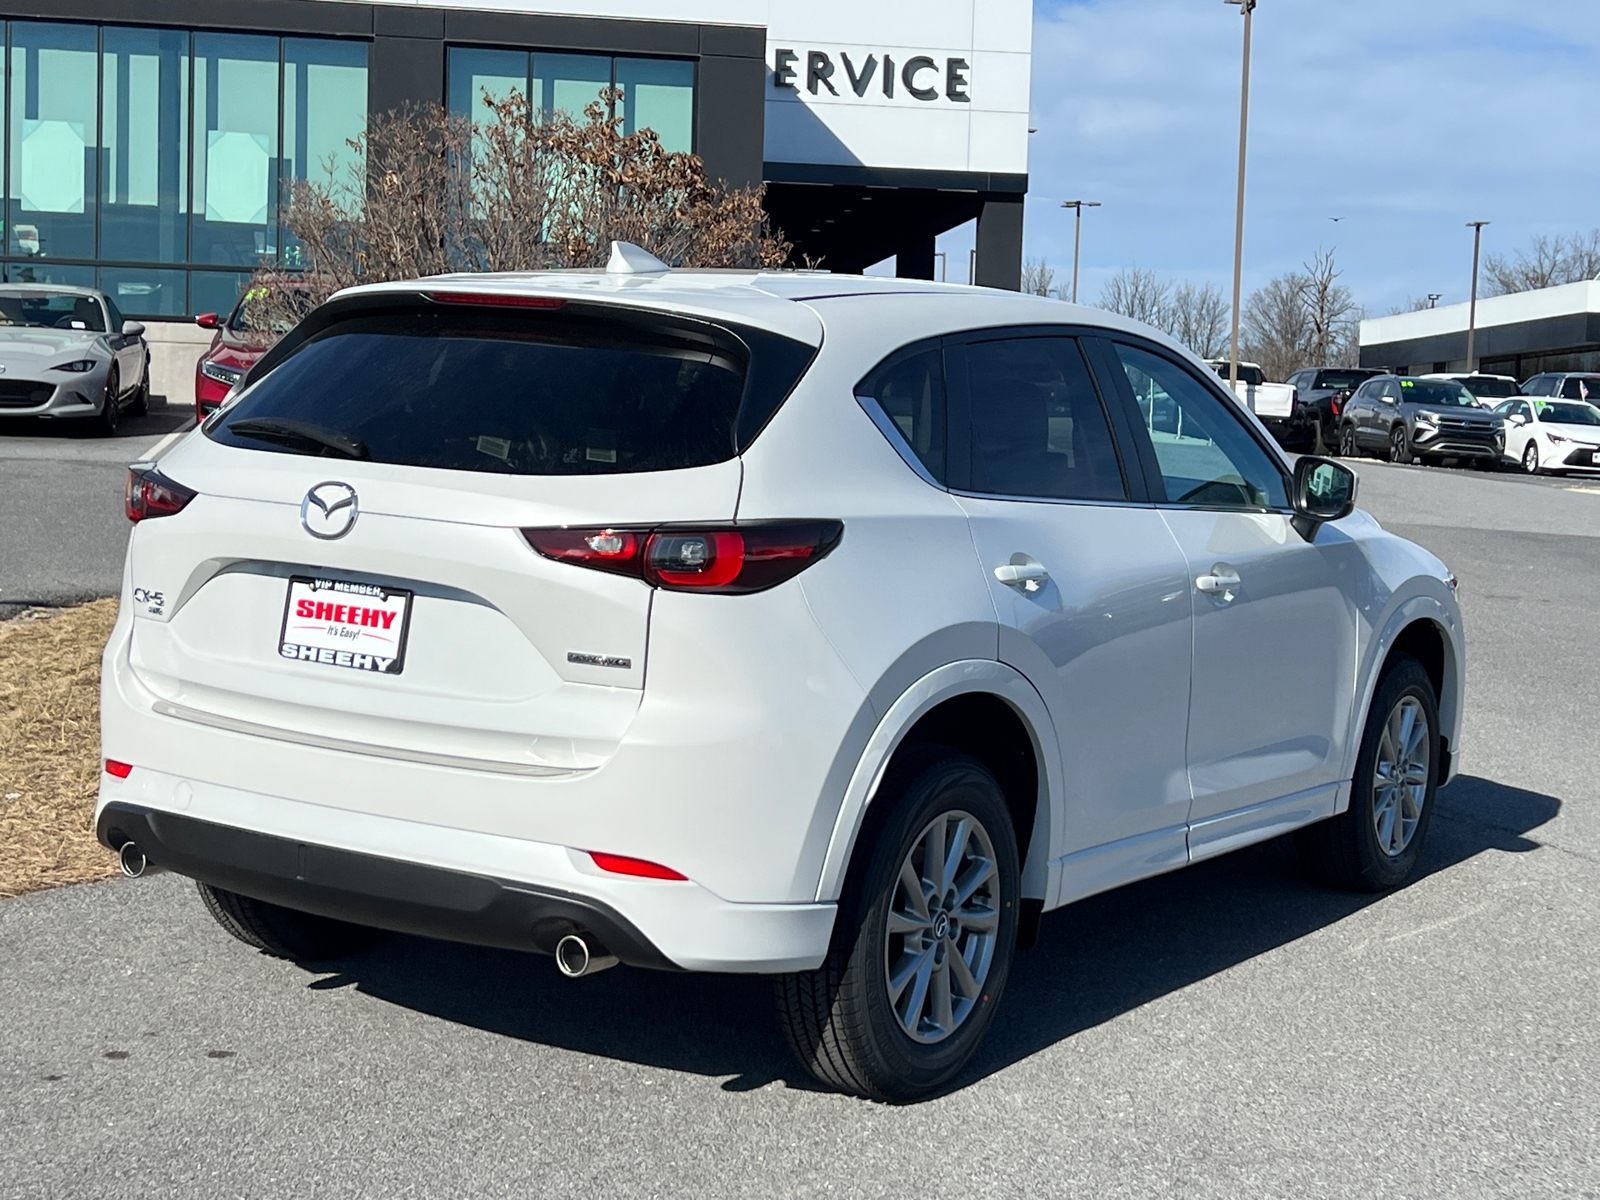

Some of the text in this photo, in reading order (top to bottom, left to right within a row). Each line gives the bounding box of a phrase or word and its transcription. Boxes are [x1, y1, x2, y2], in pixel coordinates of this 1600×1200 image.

[775, 48, 970, 103] ERVICE
[315, 579, 333, 590] VIP
[134, 587, 164, 607] CX-5
[296, 599, 397, 629] SHEEHY
[327, 625, 360, 641] It's Easy!
[282, 643, 394, 671] SHEEHY
